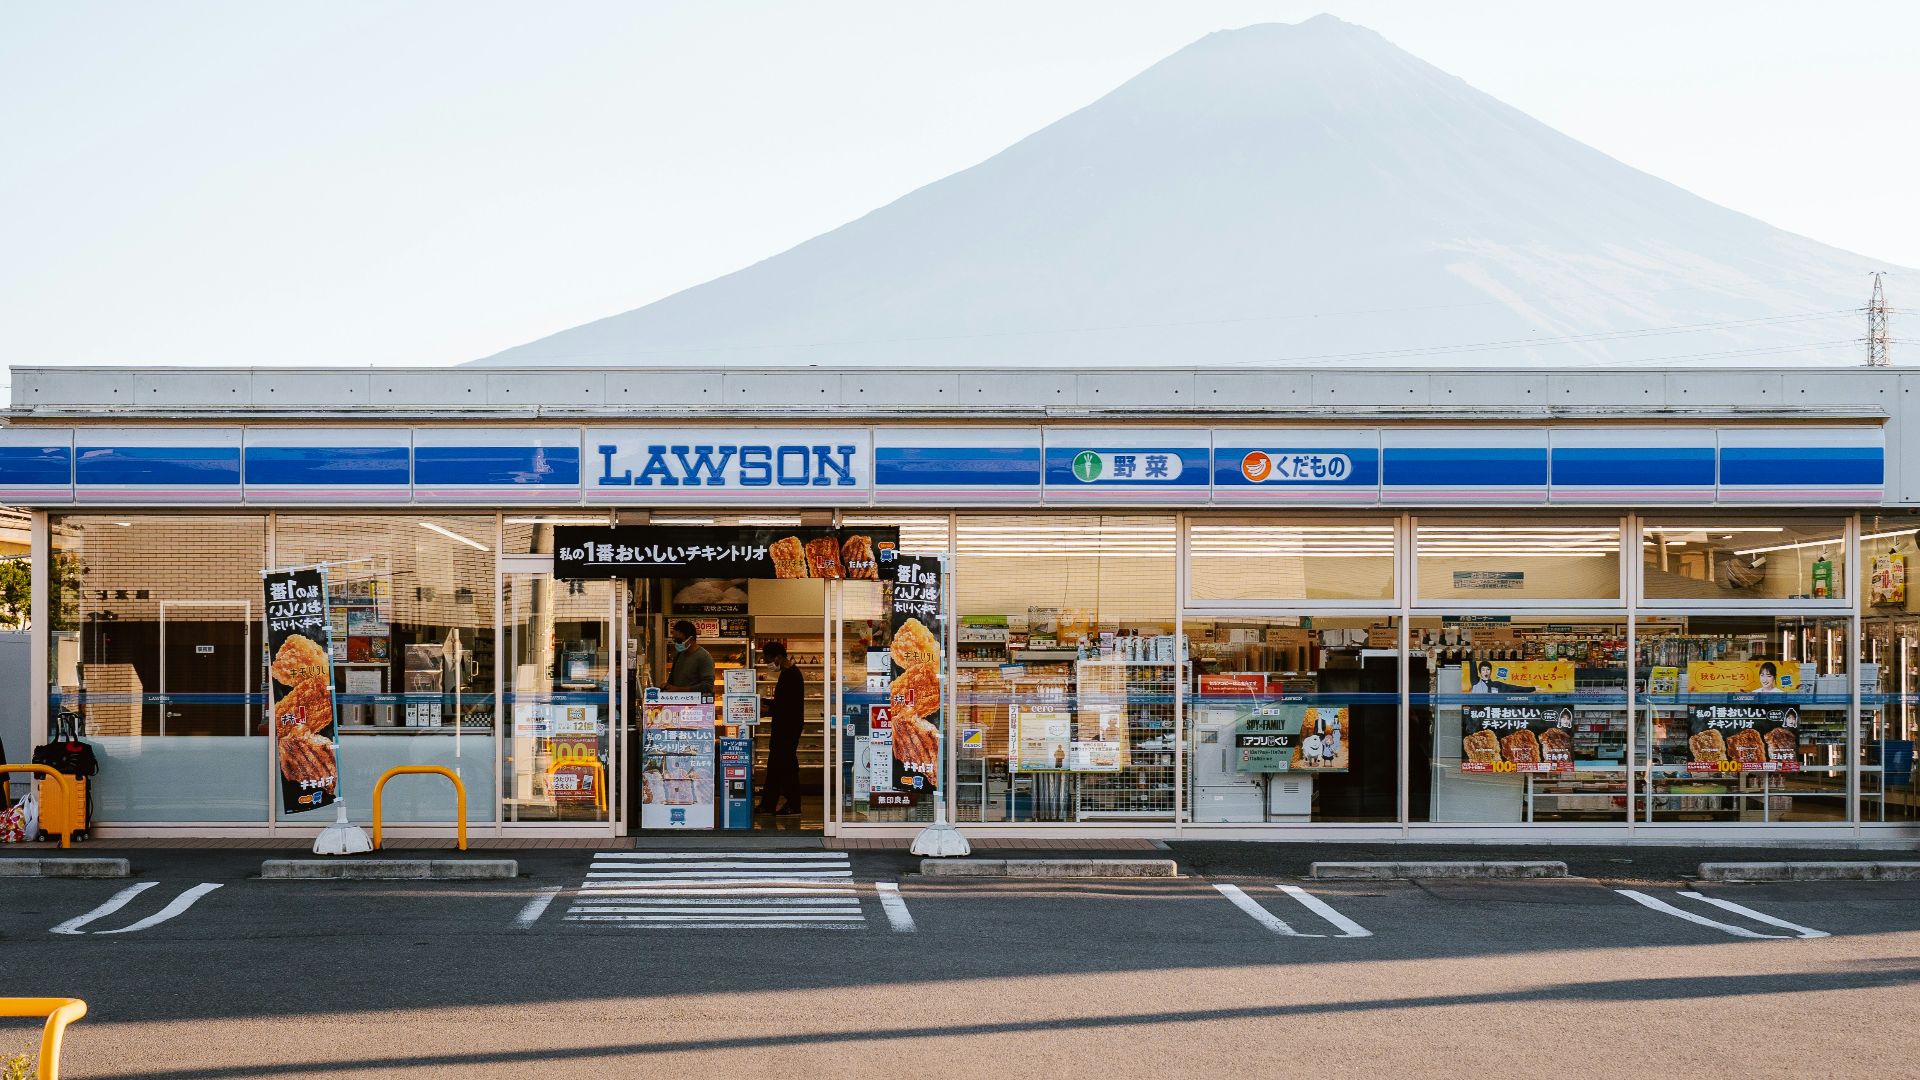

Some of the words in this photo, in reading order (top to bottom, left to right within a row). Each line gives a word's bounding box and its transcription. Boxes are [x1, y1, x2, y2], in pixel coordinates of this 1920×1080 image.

[598, 445, 856, 486] LAWSON
[1113, 455, 1168, 478] 野菜
[1276, 455, 1345, 478] くだもの
[560, 541, 767, 563] 私の1番おいしいチキントリオ
[849, 560, 875, 569] たんチキ
[1031, 705, 1054, 713] cero
[1470, 707, 1540, 719] 私の1番おいしい
[1696, 706, 1766, 718] 私の1番おいしい
[1482, 720, 1529, 730] チキントリオ
[1708, 720, 1755, 729] チキントリオ
[878, 796, 910, 804] 無印良品
